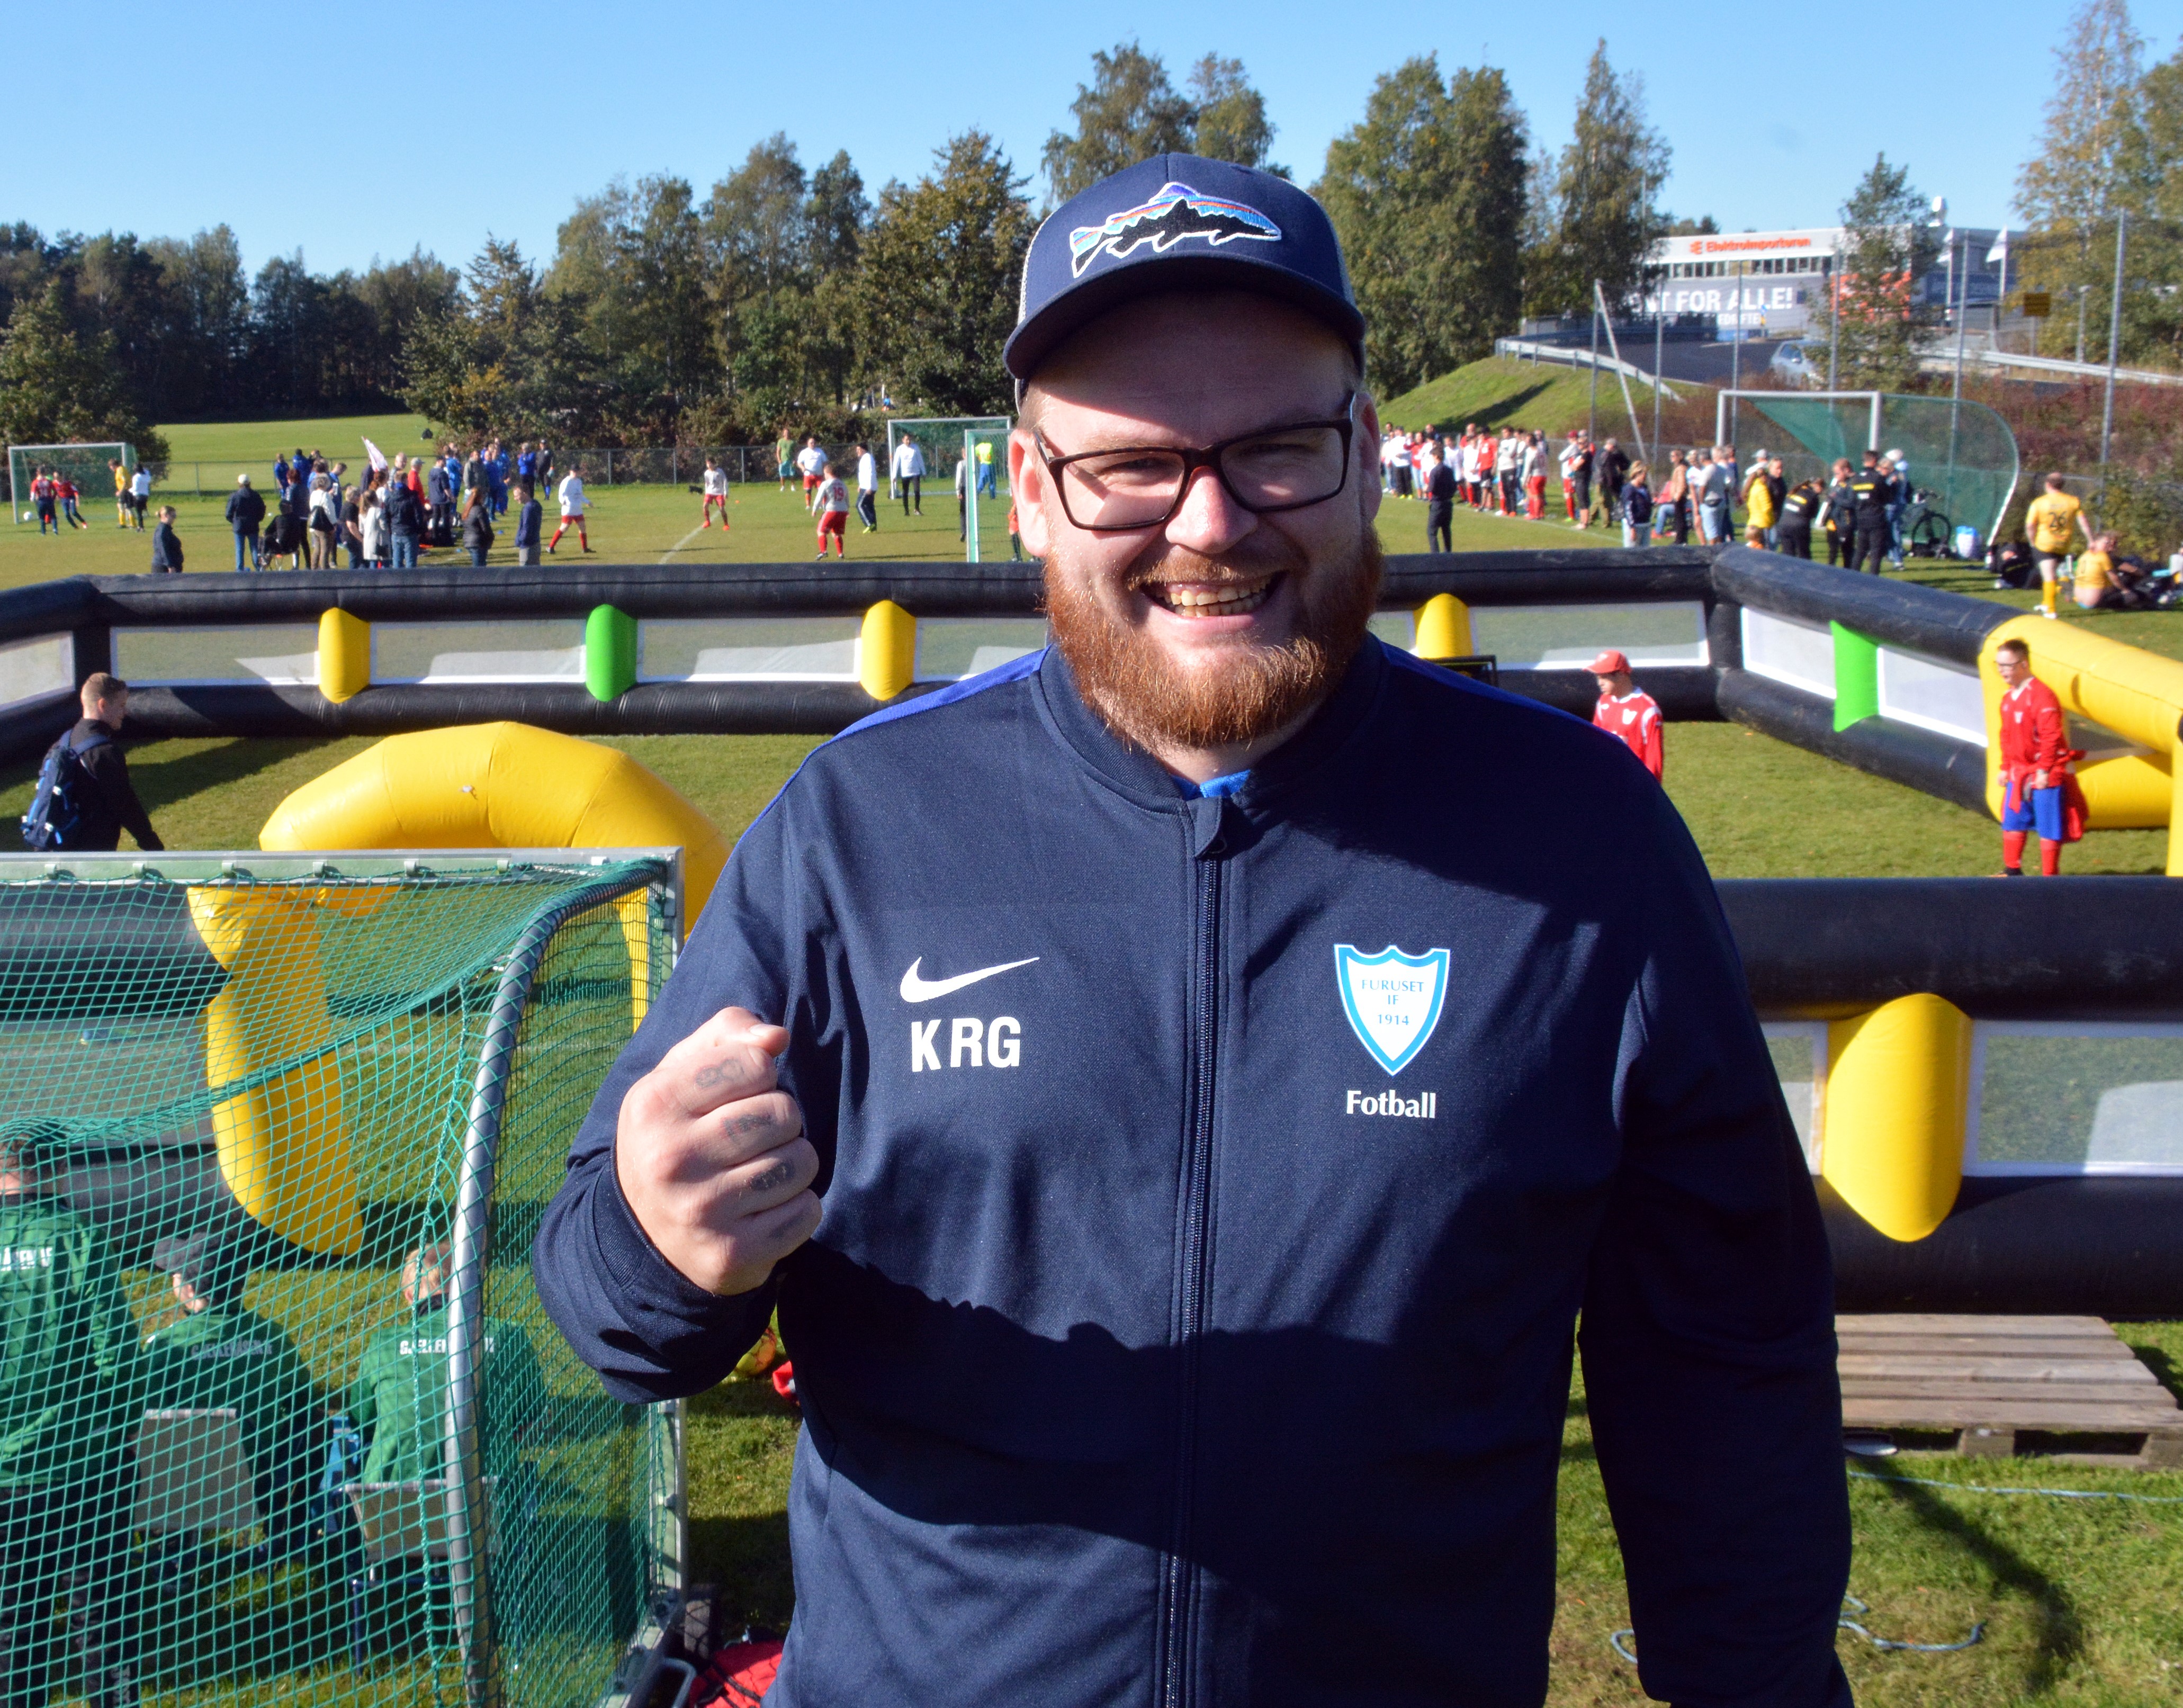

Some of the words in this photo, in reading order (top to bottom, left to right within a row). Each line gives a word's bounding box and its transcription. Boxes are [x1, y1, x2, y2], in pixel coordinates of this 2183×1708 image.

[1676, 290, 1721, 312] FOR
[1727, 287, 1792, 311] ALLE!
[833, 486, 845, 501] 19
[2048, 511, 2068, 528] 26
[1362, 980, 1424, 992] FURUSET
[1388, 995, 1399, 1004] IF
[1377, 1014, 1409, 1025] 1914
[911, 1016, 1021, 1073] KRG
[1346, 1090, 1436, 1119] Fotball
